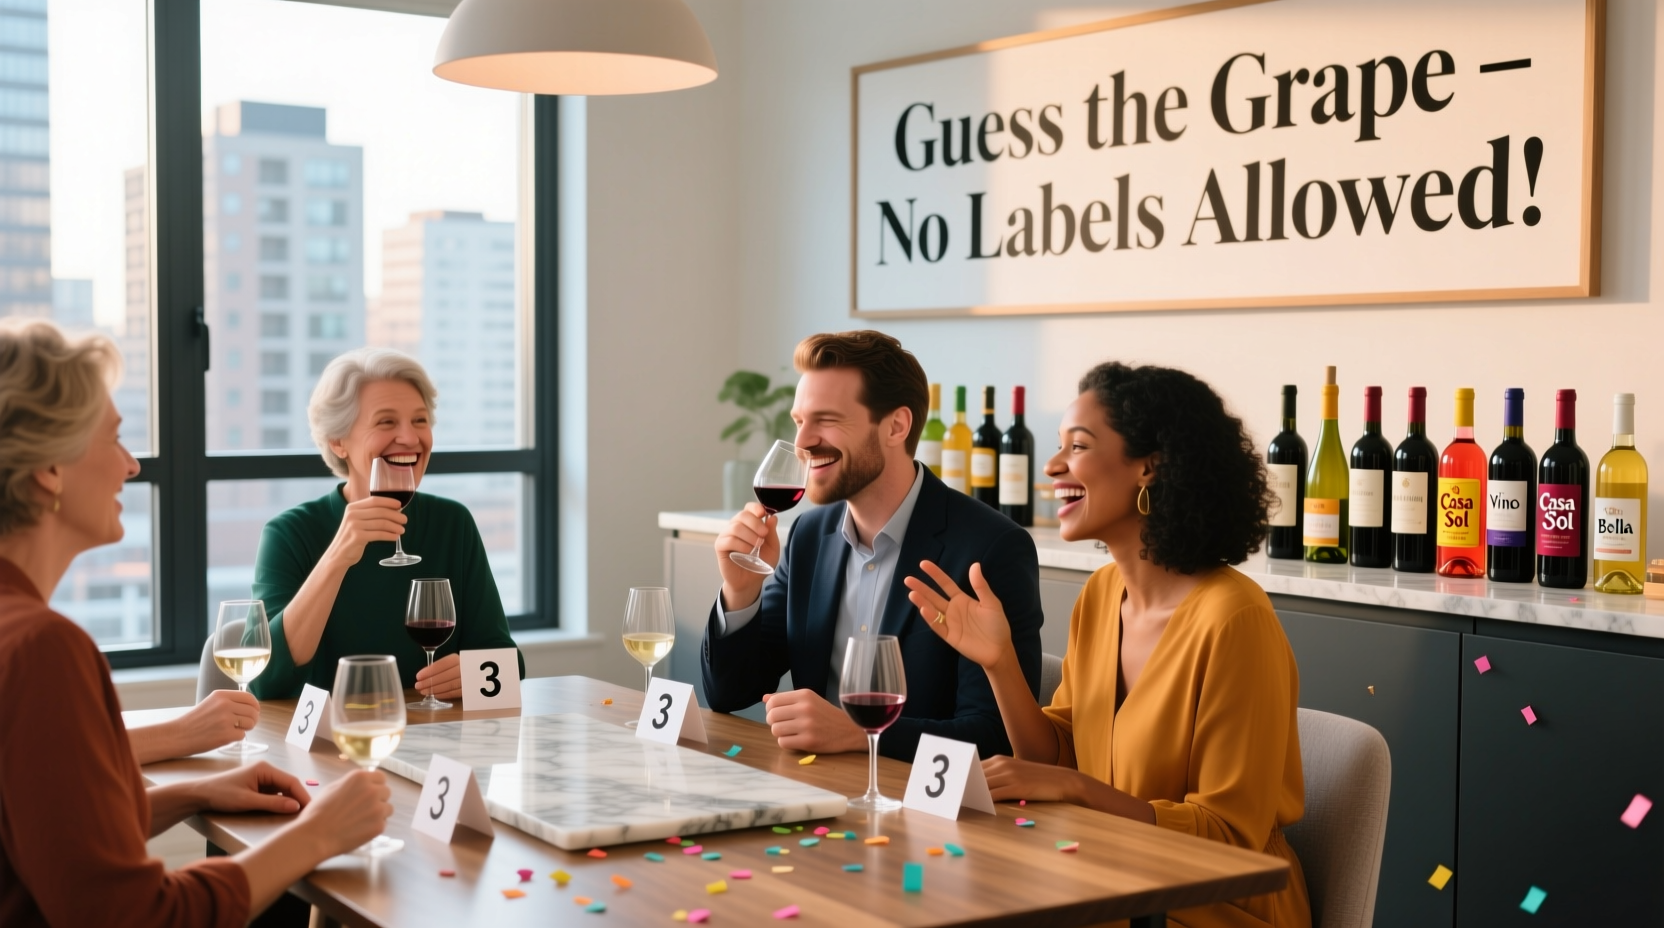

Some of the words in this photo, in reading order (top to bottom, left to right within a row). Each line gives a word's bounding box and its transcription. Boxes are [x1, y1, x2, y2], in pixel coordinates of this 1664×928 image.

[894, 102, 1064, 172] Guess
[1083, 70, 1188, 151] the
[1210, 49, 1456, 143] Grape
[875, 197, 950, 266] No
[966, 173, 1165, 260] Labels
[1181, 134, 1545, 247] Allowed!
[1440, 492, 1474, 510] Casa
[1444, 510, 1469, 528] Sol
[1539, 491, 1576, 512] Casa
[1541, 511, 1574, 531] Sol
[479, 660, 502, 698] 3
[297, 699, 315, 735] 3
[651, 693, 673, 730] 3
[925, 753, 950, 798] 3
[429, 776, 450, 821] 3
